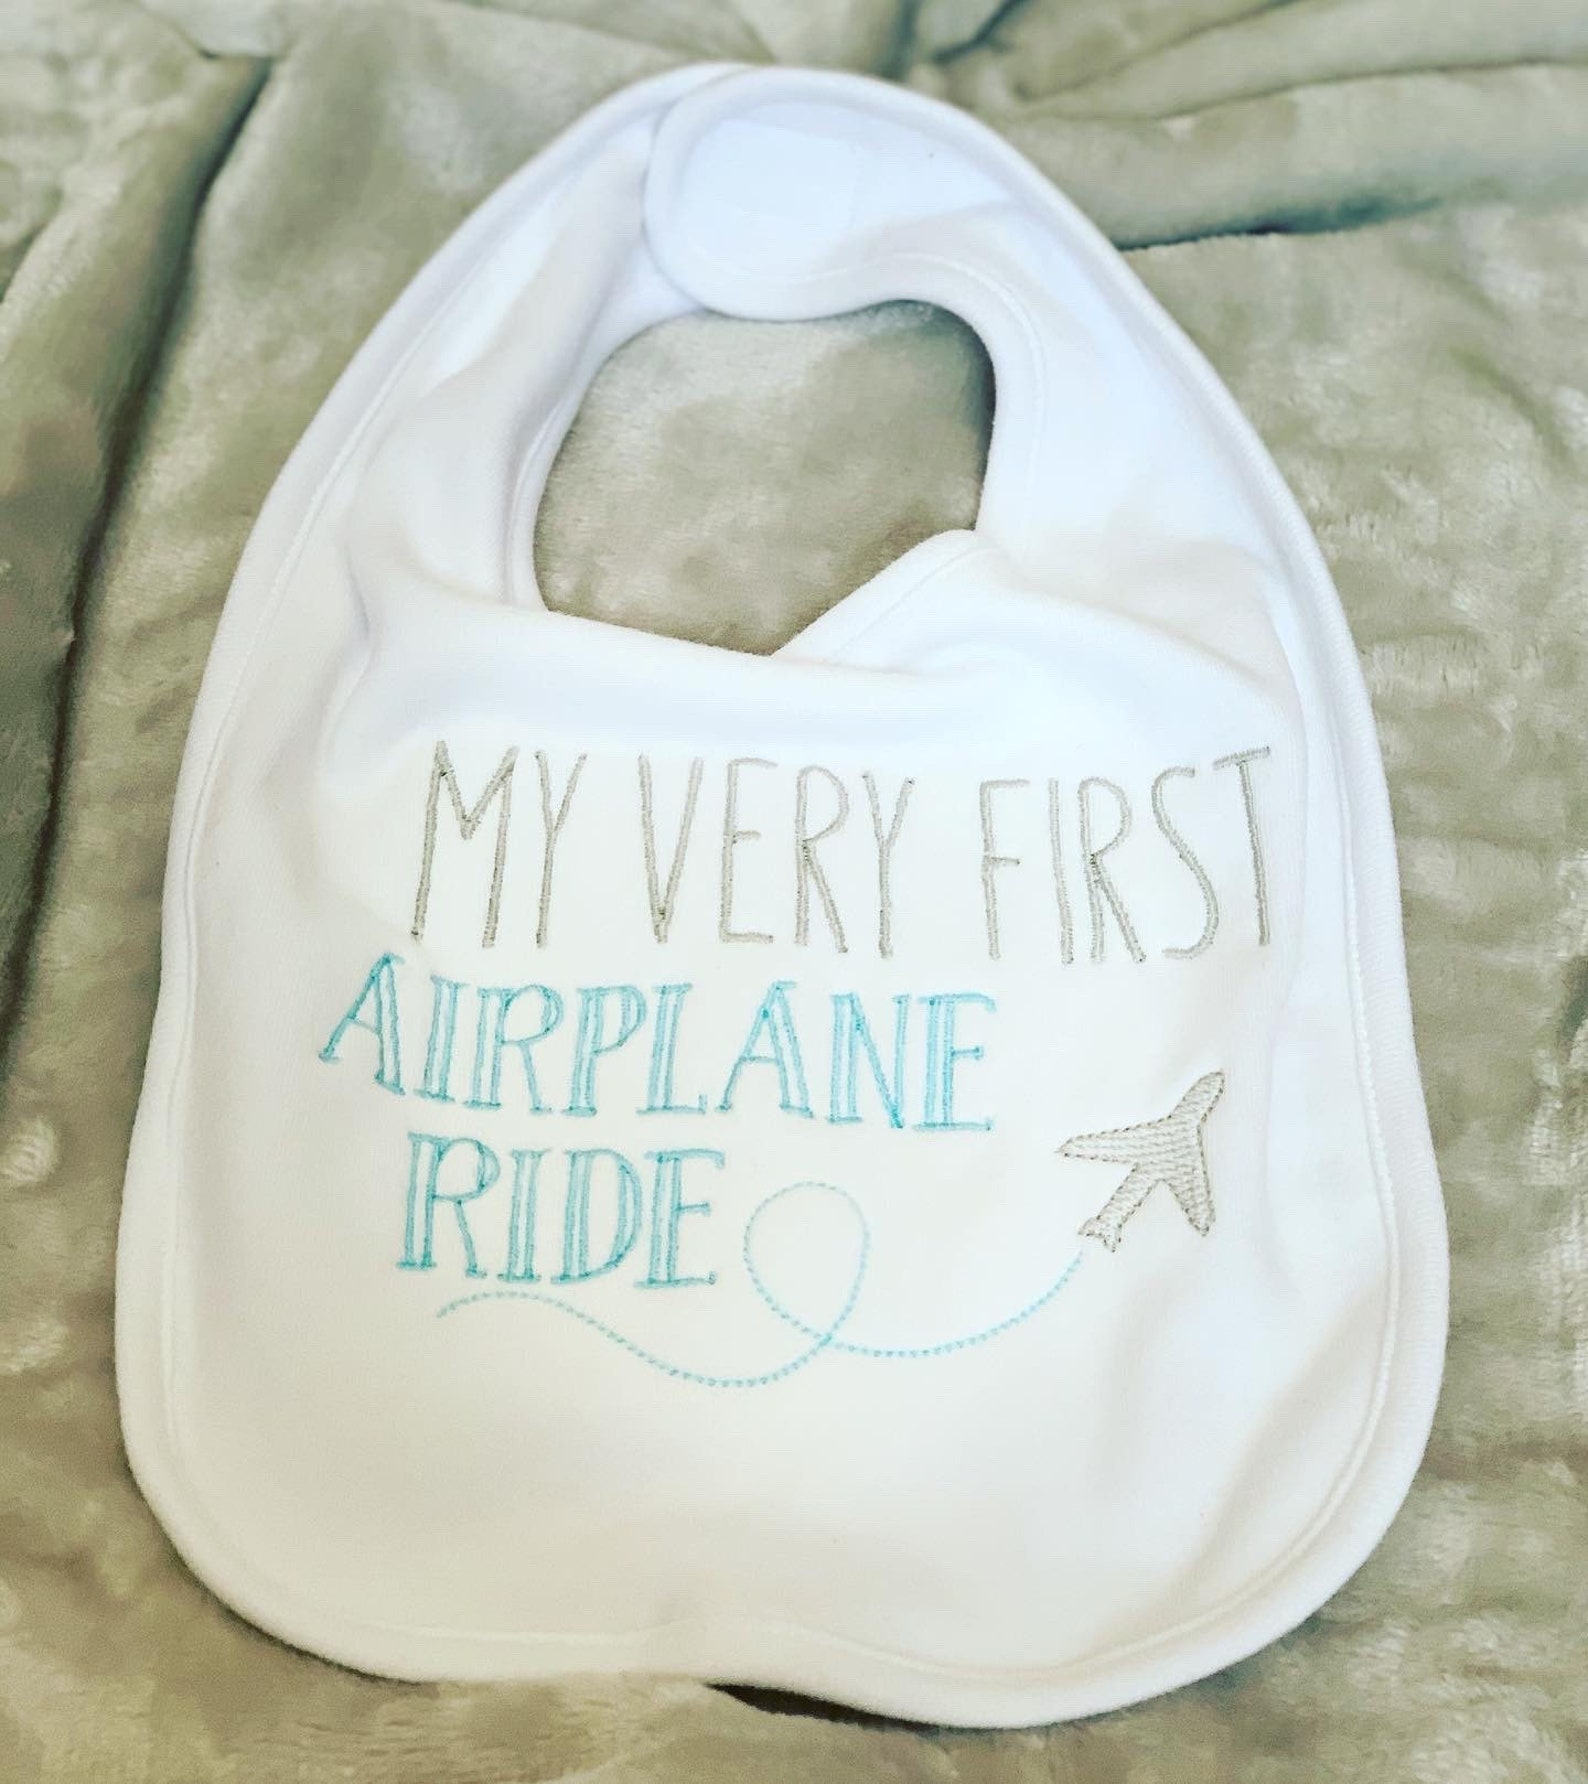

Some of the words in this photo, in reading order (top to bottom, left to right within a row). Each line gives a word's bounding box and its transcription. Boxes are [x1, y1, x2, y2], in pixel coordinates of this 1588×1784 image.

[410, 740, 588, 949] MY
[637, 755, 914, 959] VERY
[980, 746, 1271, 964] FIRST
[317, 951, 996, 1133] AIRPLANE
[395, 1132, 726, 1290] RIDE
